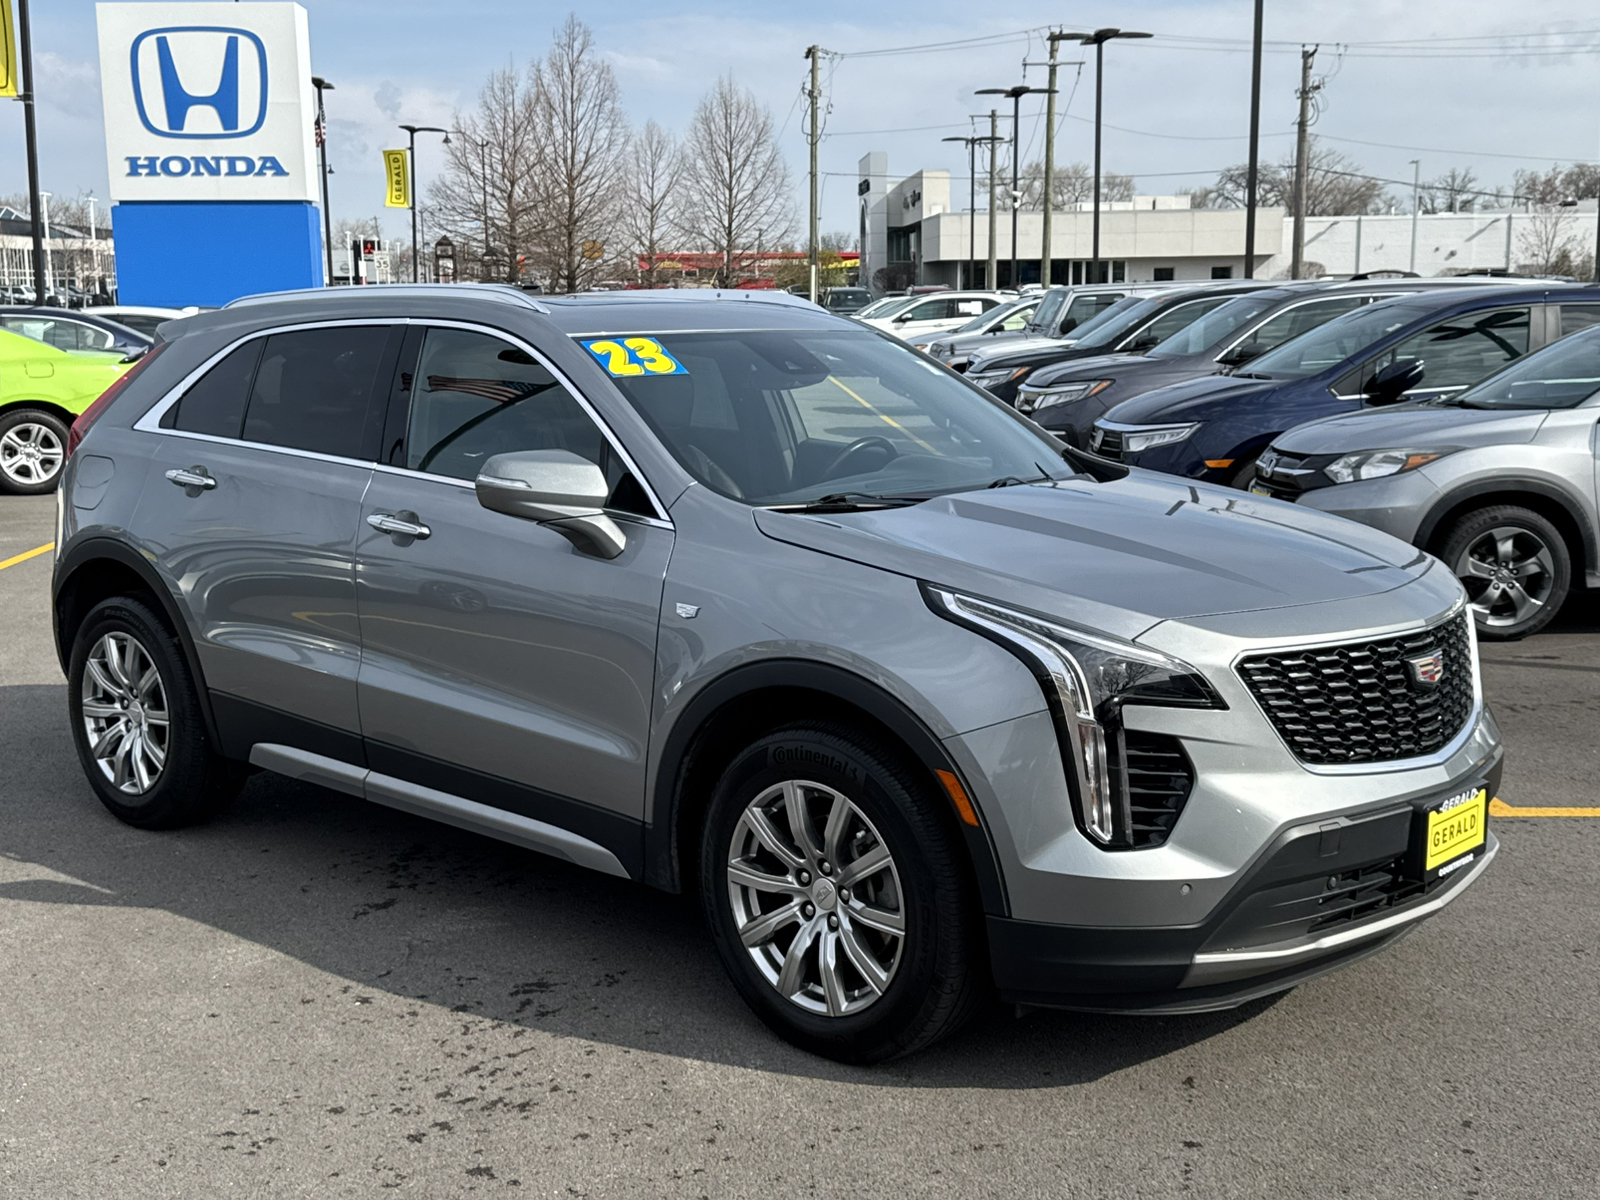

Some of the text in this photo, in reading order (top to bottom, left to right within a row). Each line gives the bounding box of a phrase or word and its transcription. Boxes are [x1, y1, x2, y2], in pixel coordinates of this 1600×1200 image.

[125, 156, 290, 177] HONDA
[392, 157, 403, 200] GERALD
[376, 260, 389, 269] 35
[589, 338, 676, 375] 23
[773, 745, 849, 775] Continental
[1433, 814, 1476, 848] GERALD
